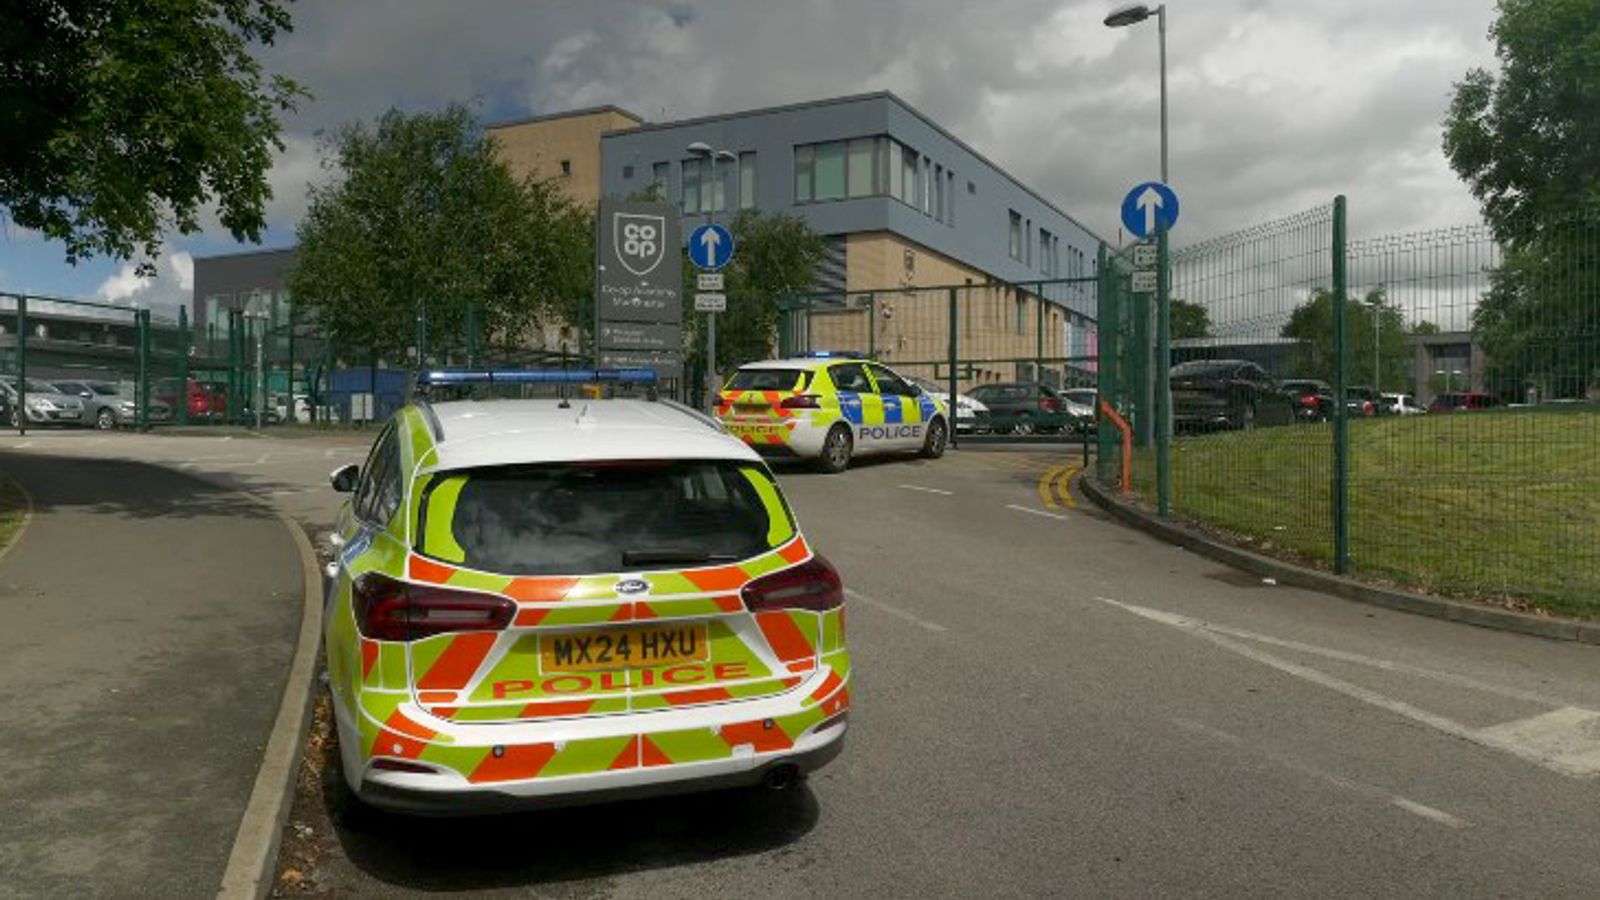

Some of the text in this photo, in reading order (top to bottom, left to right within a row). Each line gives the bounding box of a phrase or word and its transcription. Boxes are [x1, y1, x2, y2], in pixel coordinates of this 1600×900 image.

[859, 425, 921, 441] POLICE
[553, 628, 697, 666] MX24 HXU
[492, 661, 751, 699] POLICE
